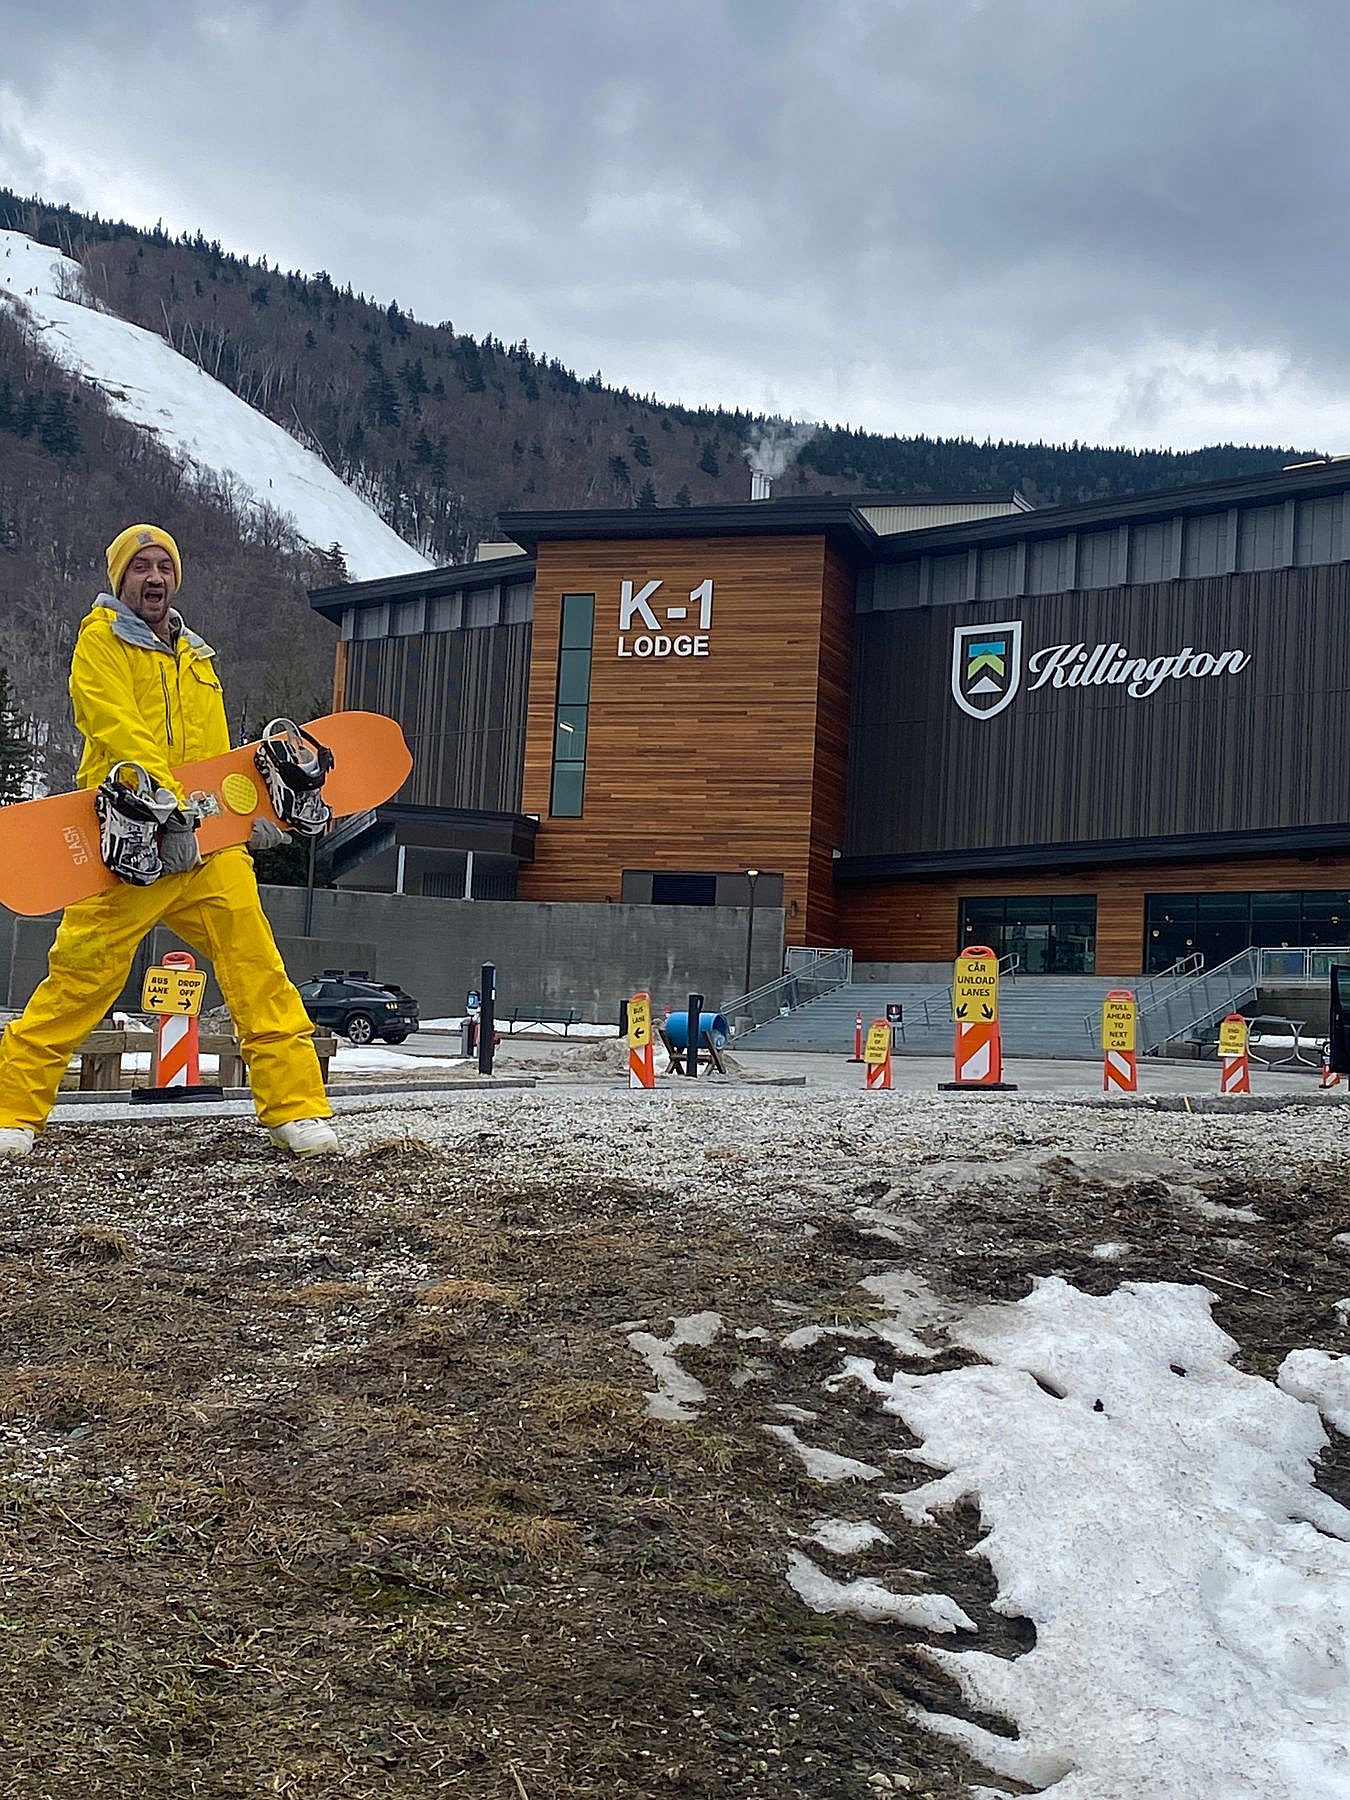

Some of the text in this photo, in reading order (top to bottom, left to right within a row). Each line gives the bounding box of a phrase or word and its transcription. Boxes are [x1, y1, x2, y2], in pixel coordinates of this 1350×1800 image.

[619, 579, 713, 630] K-1
[617, 635, 710, 657] LODGE
[1027, 642, 1252, 699] Killington
[61, 825, 88, 865] SLASH
[967, 963, 986, 973] CAR
[151, 976, 169, 985] BUS
[177, 979, 201, 988] DROP
[957, 975, 996, 985] UNLOAD
[147, 985, 169, 995] LANE
[179, 988, 196, 997] OFF
[961, 988, 990, 997] LANES
